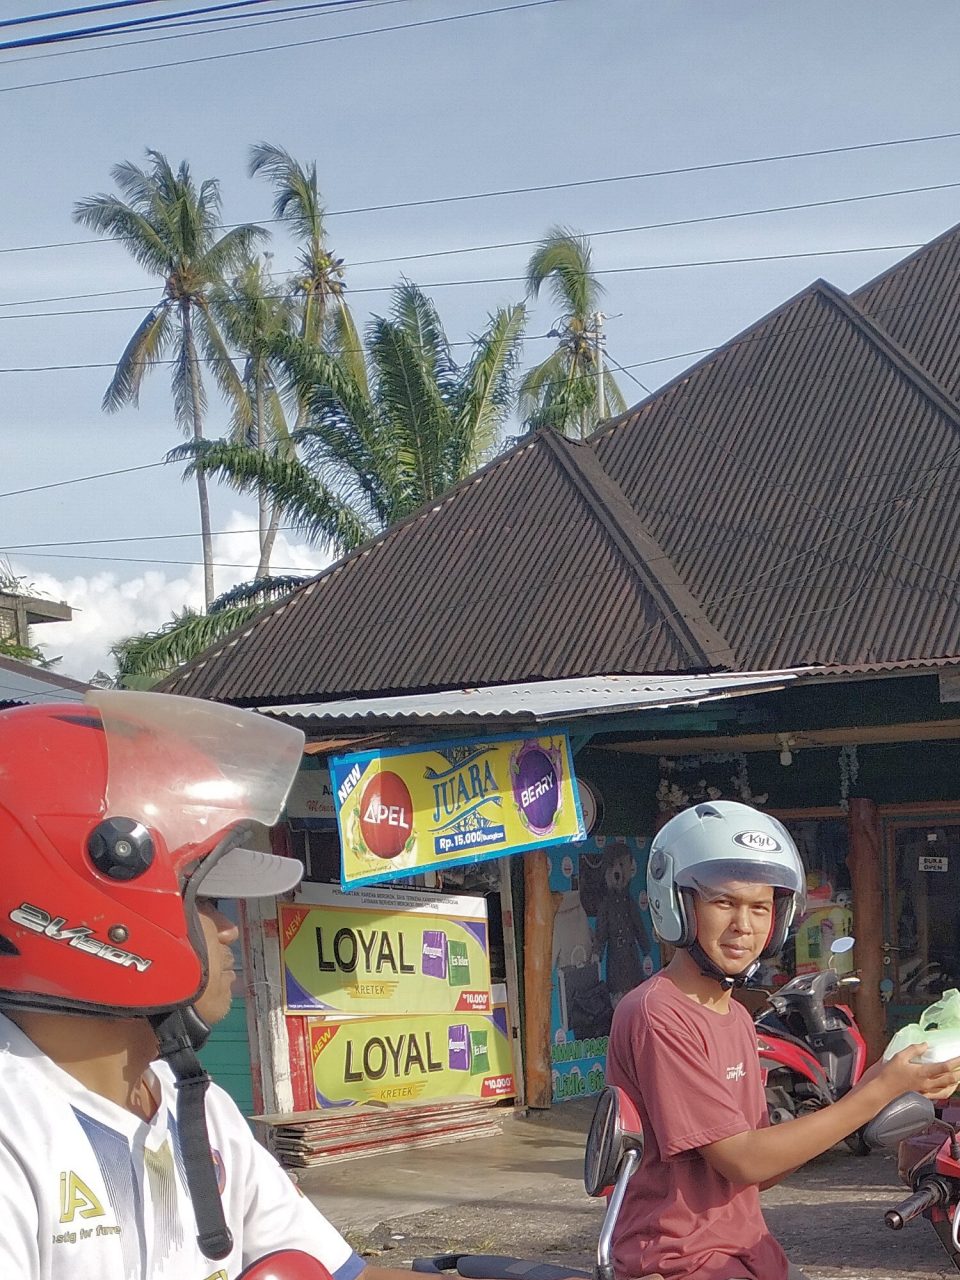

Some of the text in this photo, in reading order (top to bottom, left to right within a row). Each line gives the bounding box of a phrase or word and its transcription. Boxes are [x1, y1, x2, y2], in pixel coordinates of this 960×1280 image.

[337, 763, 362, 804] NEW
[432, 760, 499, 823] JUARA
[520, 771, 555, 809] BERRY
[363, 798, 409, 829] APEL
[285, 913, 302, 941] NEW
[315, 926, 416, 975] LOYAL
[354, 984, 385, 995] KRETEK
[312, 1028, 331, 1055] NEW
[343, 1031, 444, 1083] LOYAL
[380, 1087, 413, 1099] KRETEK
